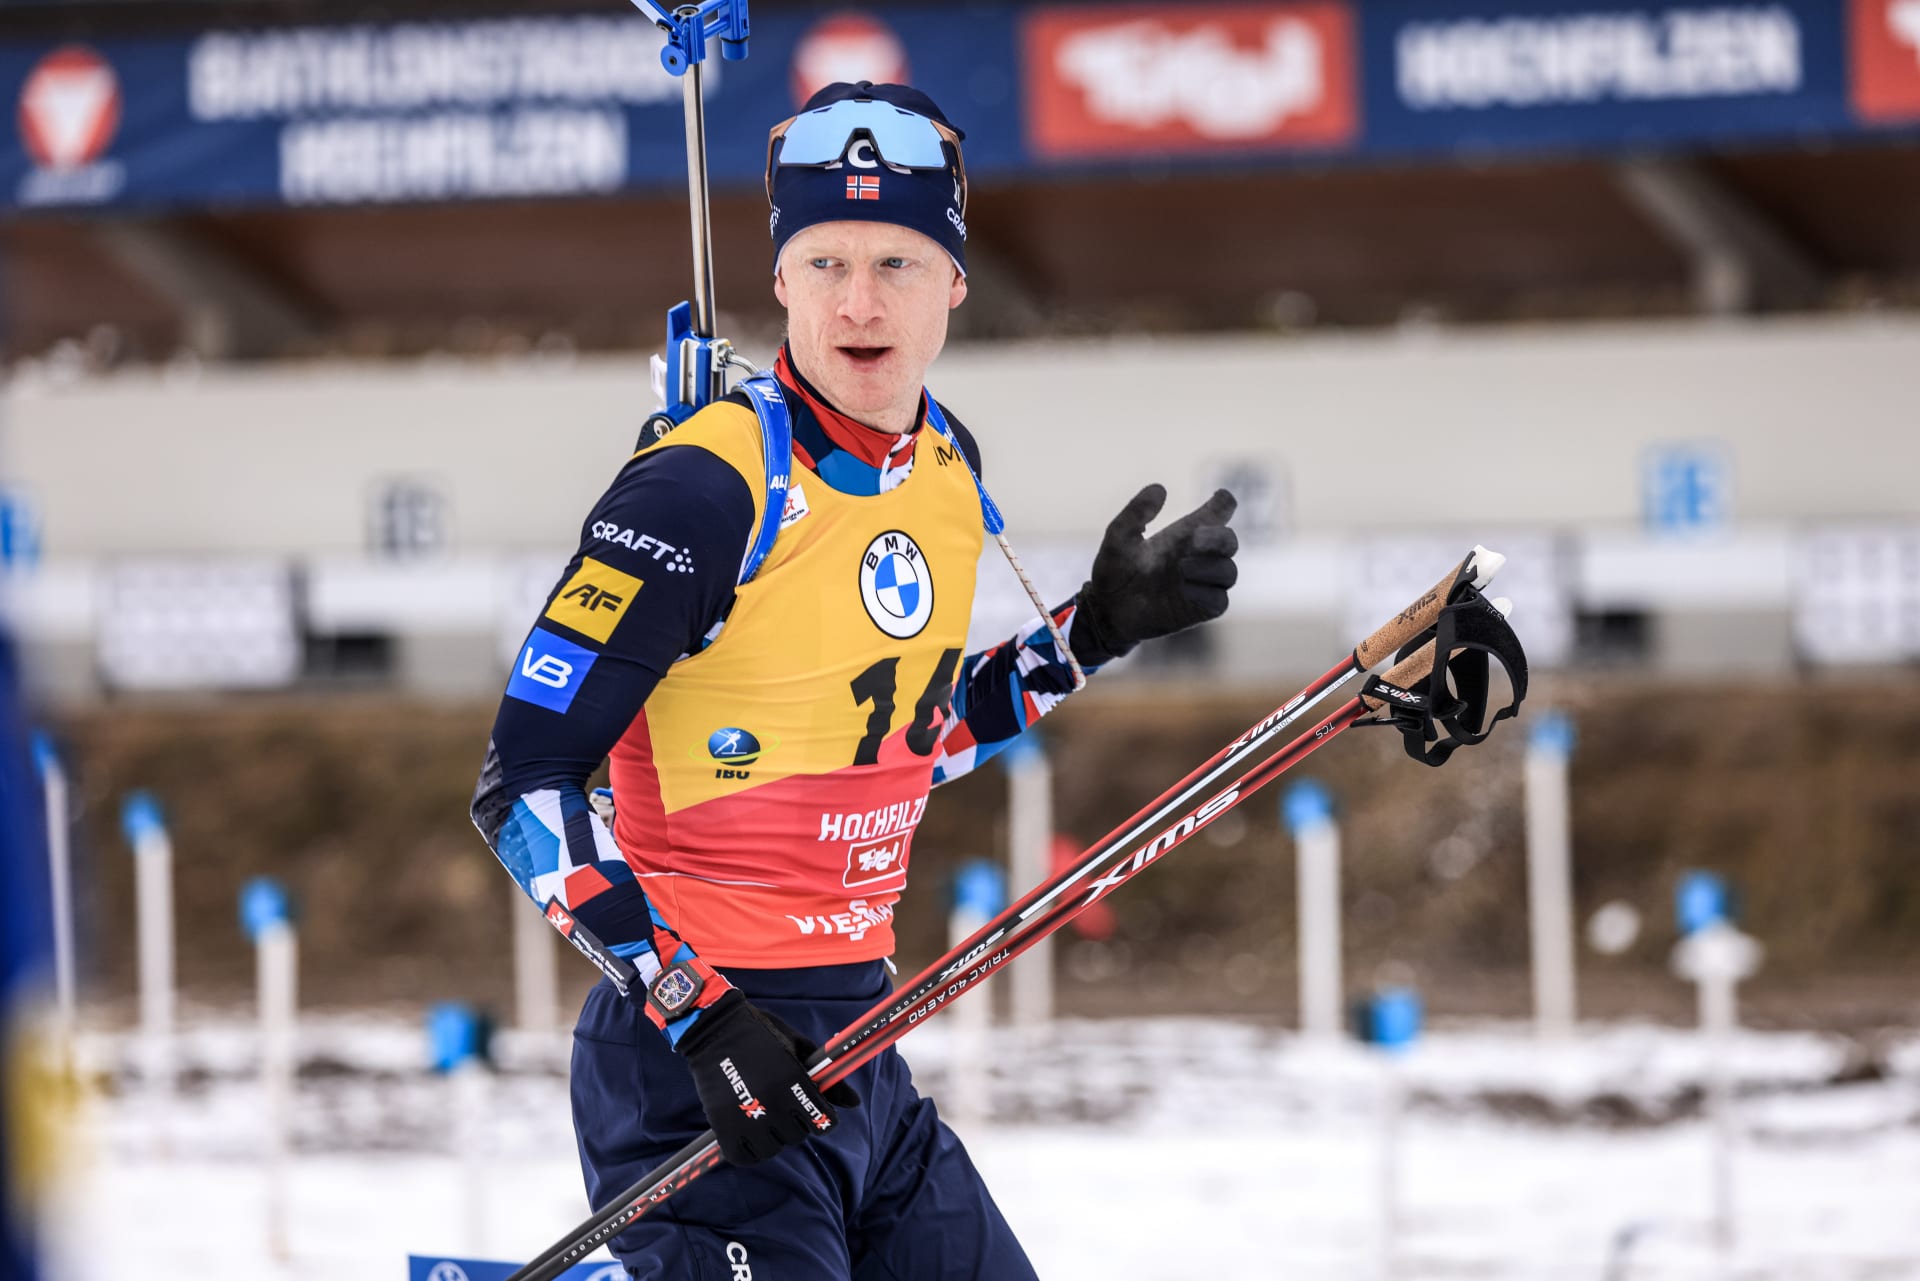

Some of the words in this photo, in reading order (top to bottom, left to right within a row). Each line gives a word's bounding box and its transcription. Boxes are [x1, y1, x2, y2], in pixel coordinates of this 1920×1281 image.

[591, 520, 676, 561] CRAFT
[865, 535, 918, 571] BMW
[1315, 721, 1336, 740] TCS
[715, 768, 750, 780] IBU
[969, 947, 1010, 982] TRIAC
[948, 979, 967, 996] 4.0
[908, 991, 946, 1024] AERO
